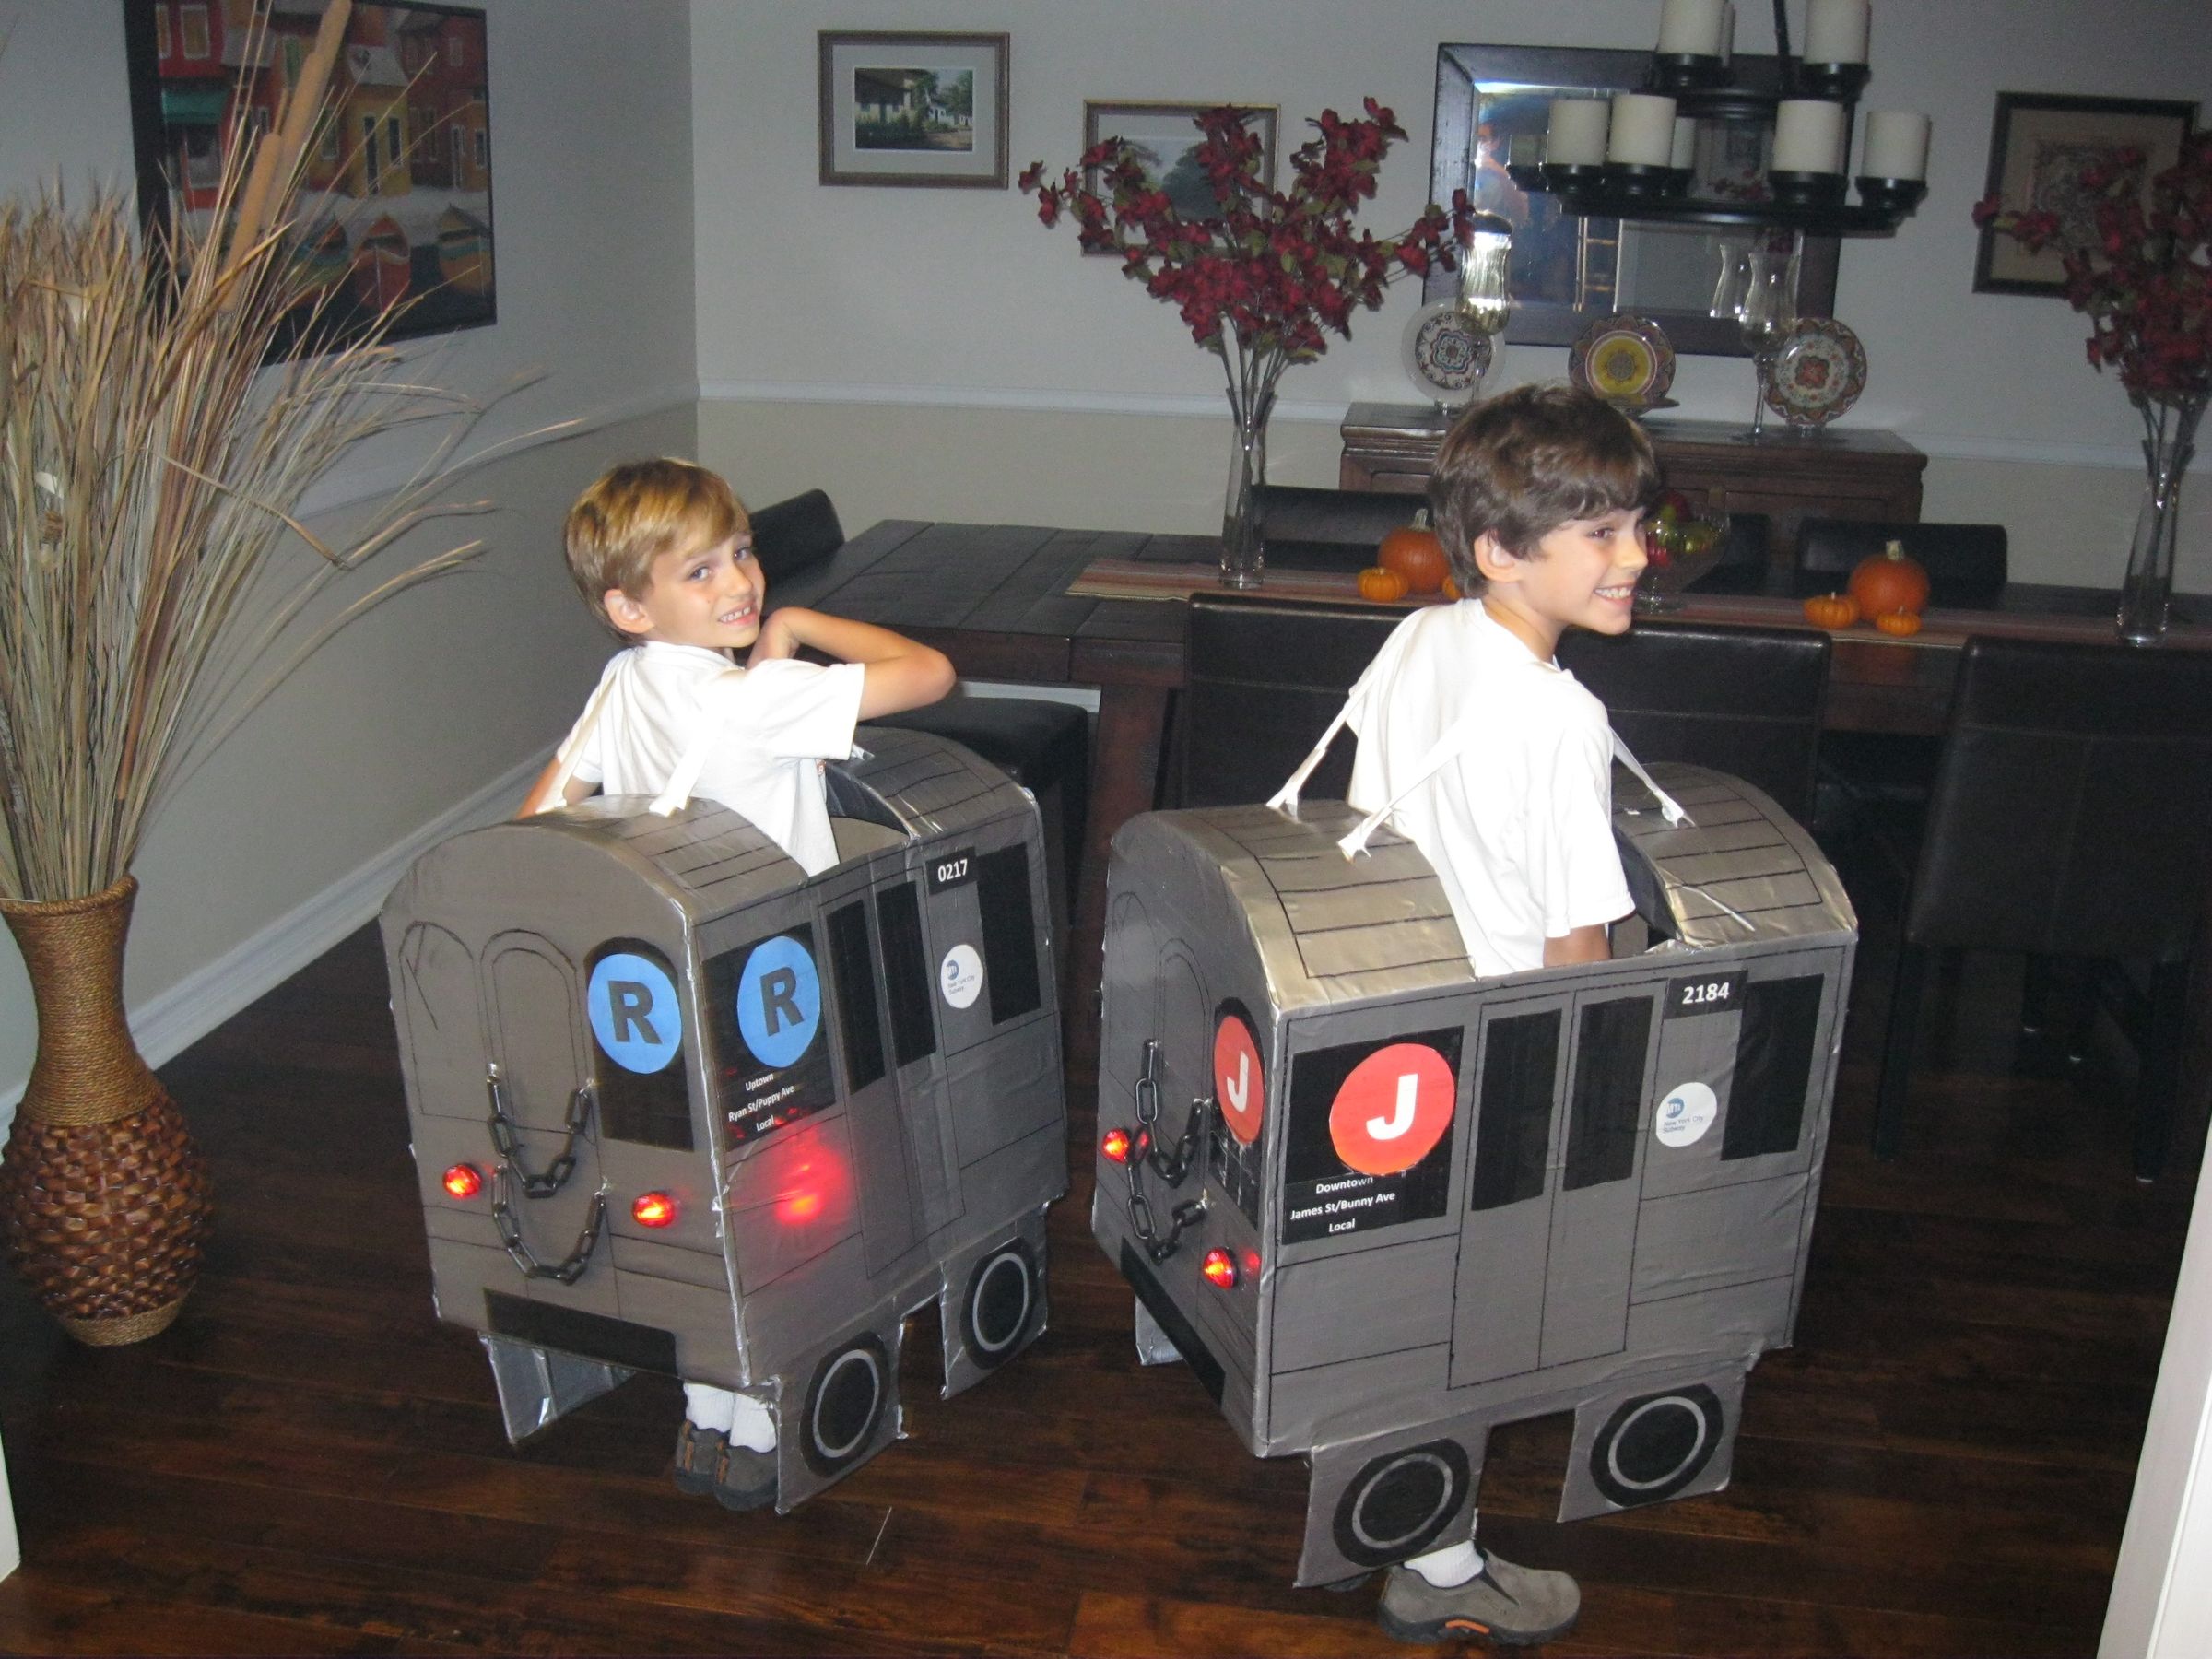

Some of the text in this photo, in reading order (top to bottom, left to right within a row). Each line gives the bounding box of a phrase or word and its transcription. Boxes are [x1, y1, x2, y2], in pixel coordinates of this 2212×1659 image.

[937, 858, 968, 882] 0217
[759, 966, 805, 1038] R
[1682, 982, 1730, 1005] 2184
[607, 980, 663, 1045] R
[745, 1073, 774, 1091] Uptown
[1227, 1050, 1249, 1112] J
[728, 1085, 795, 1123] Ryan St/Puppy Ave
[1366, 1073, 1418, 1141] J
[756, 1114, 775, 1132] Local
[1315, 1175, 1374, 1194] Downtown
[1289, 1192, 1396, 1221] James St/Bunny Ave
[1328, 1218, 1356, 1233] Local
